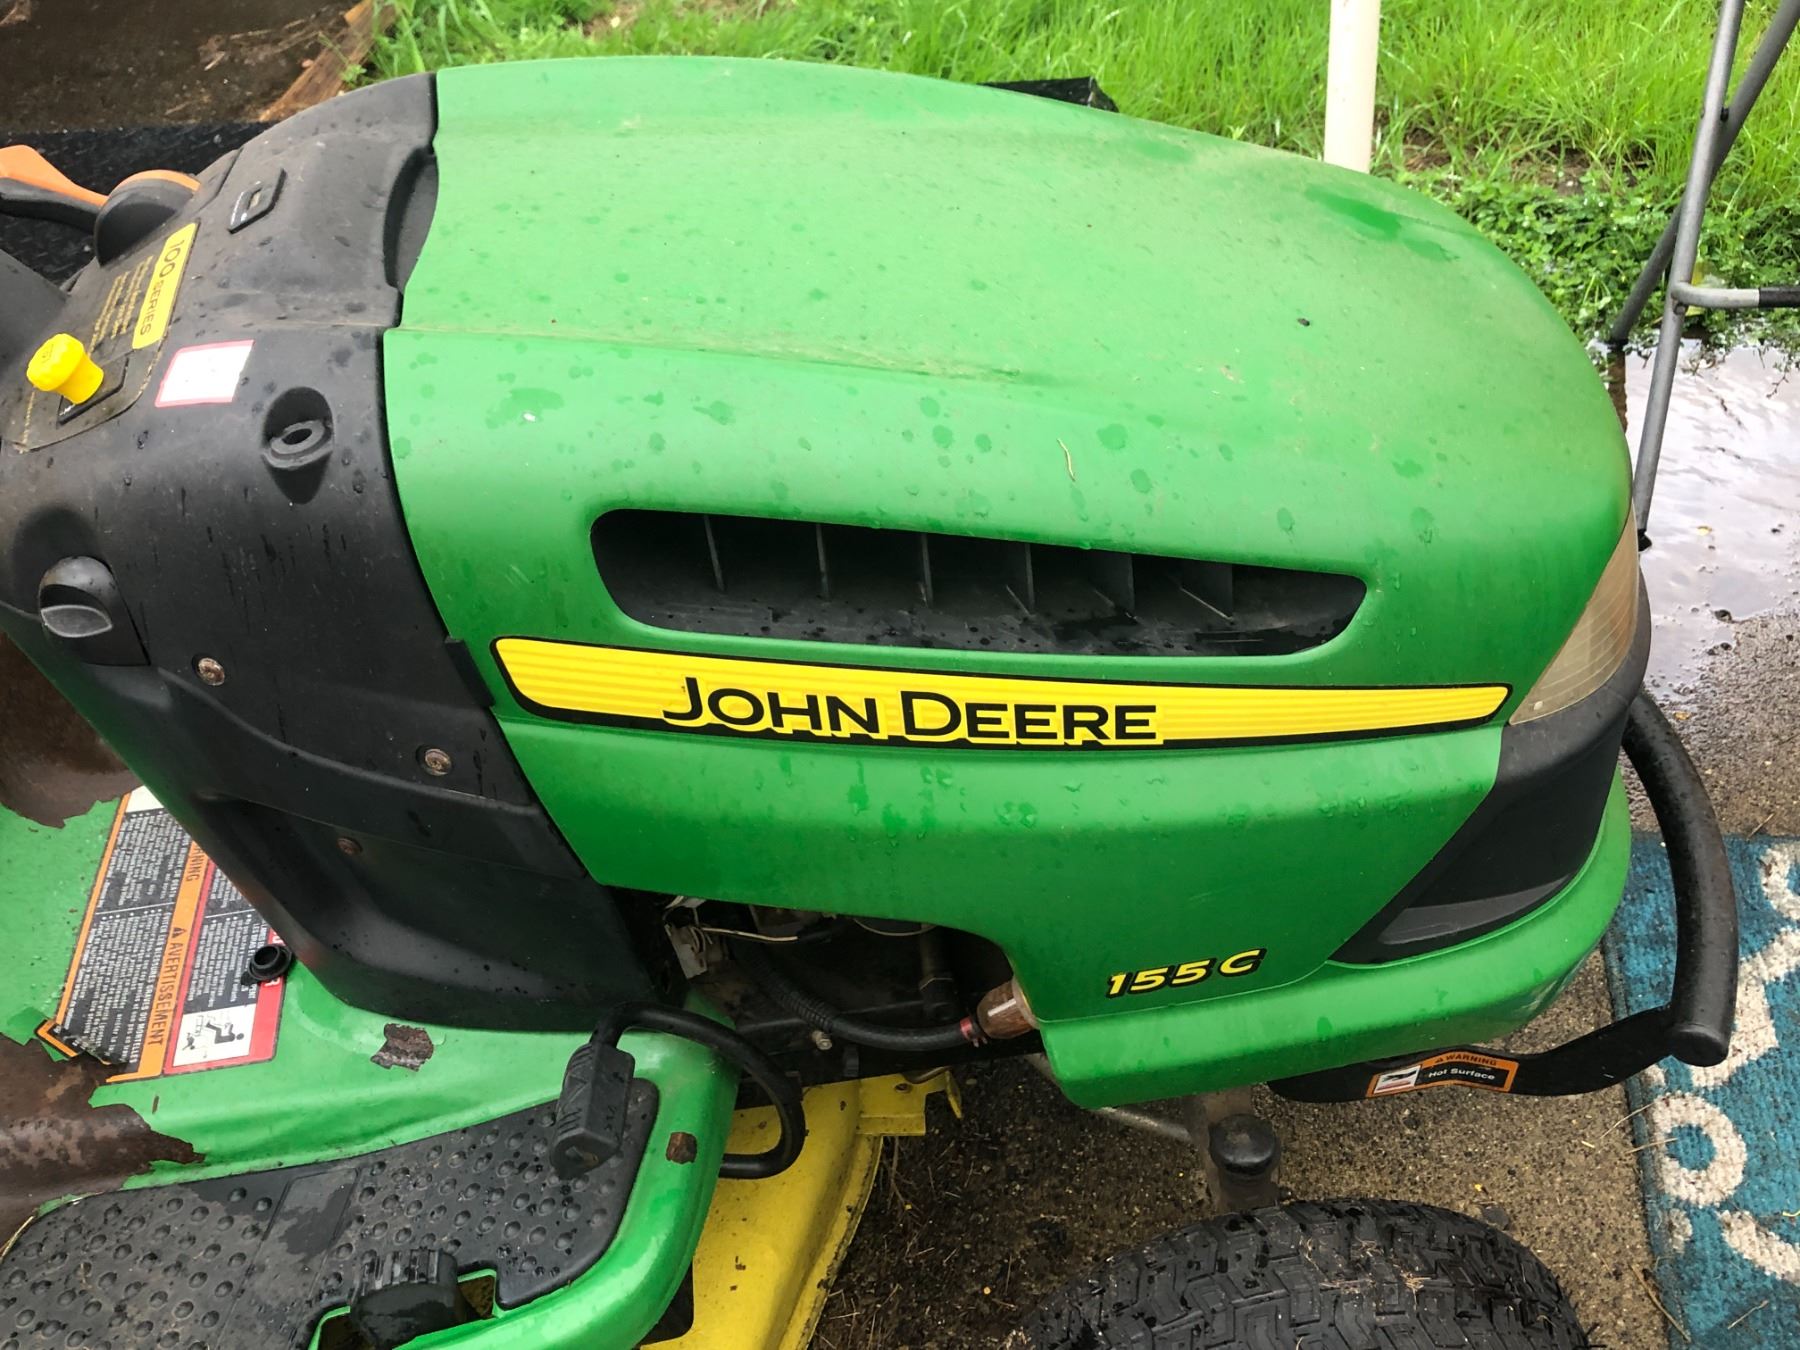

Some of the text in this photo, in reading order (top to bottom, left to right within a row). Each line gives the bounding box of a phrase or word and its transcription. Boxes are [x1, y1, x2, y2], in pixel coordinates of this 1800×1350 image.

[139, 239, 186, 336] 100 SERIES
[663, 676, 1157, 741] JOHN DEERE
[147, 941, 184, 1046] AVERTISSEMENT
[1428, 1068, 1496, 1080] Hot Surface
[1446, 1053, 1497, 1066] WARNING
